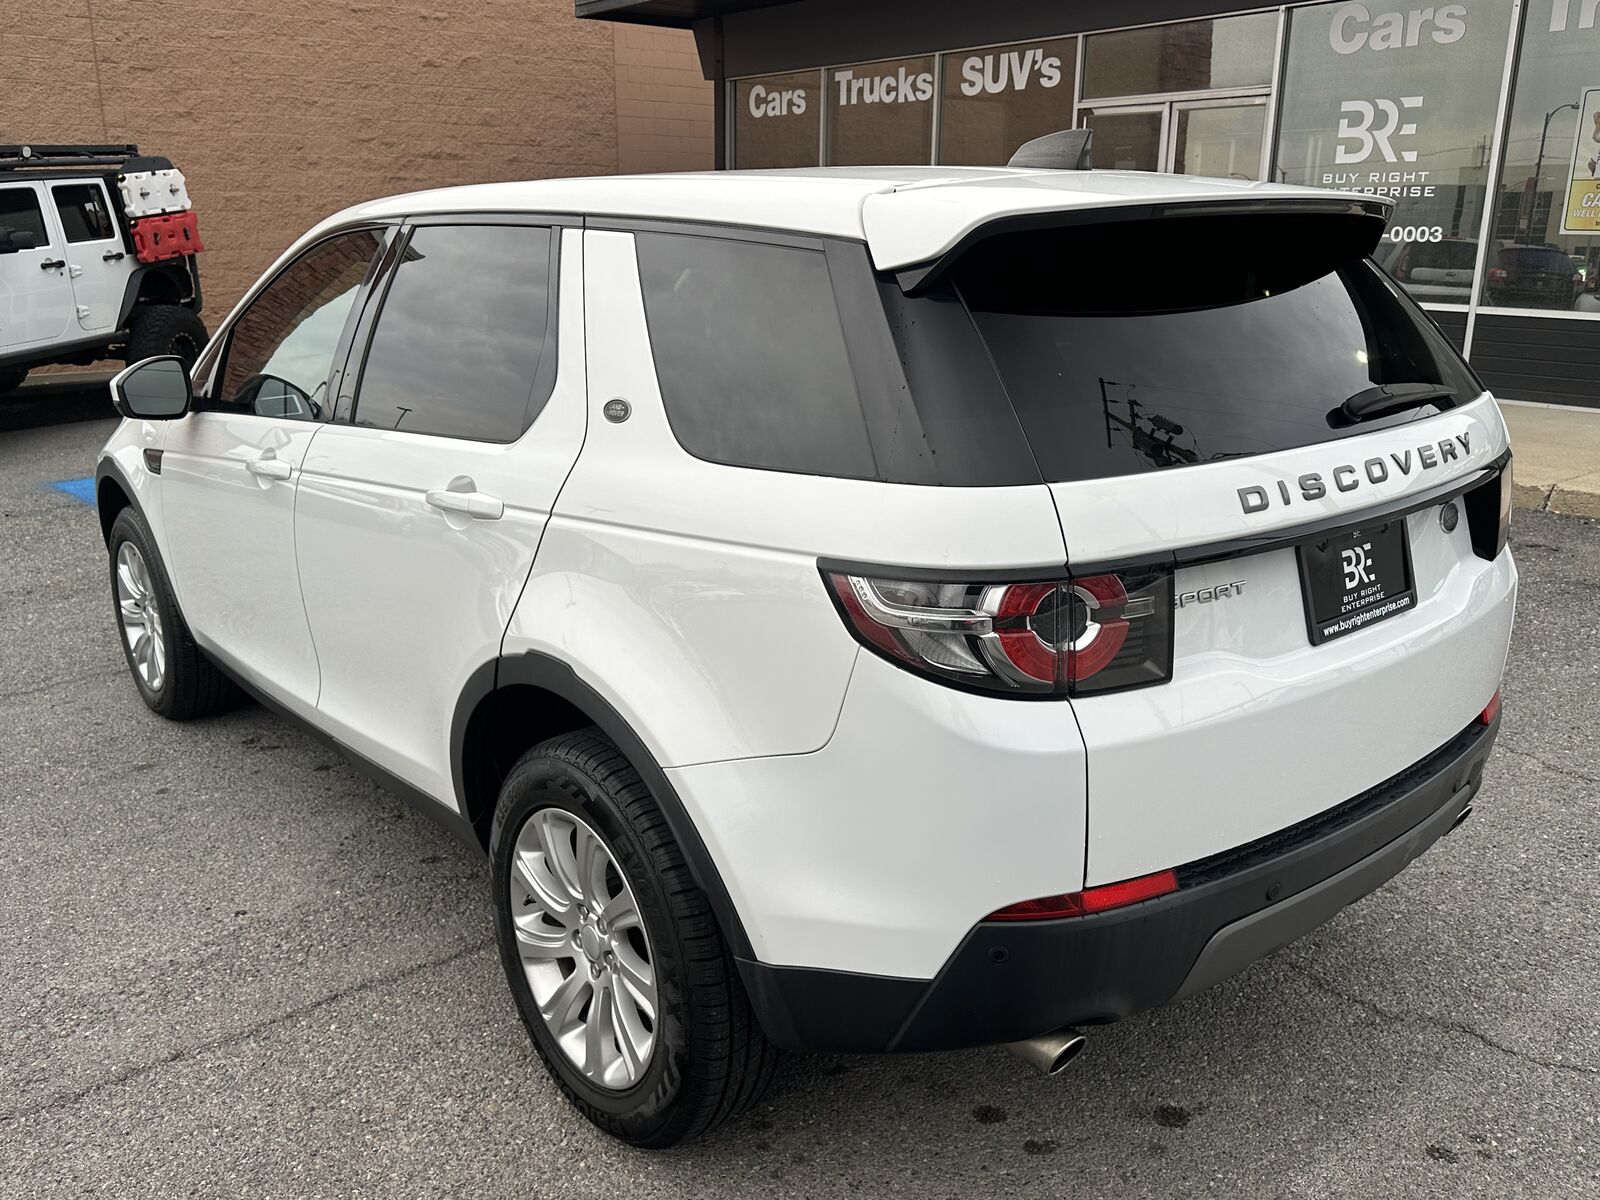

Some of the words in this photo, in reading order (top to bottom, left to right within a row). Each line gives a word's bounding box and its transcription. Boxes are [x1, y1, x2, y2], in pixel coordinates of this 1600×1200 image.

[1329, 3, 1467, 54] Cars
[834, 66, 934, 106] Trucks
[960, 48, 1061, 97] SUV's
[749, 84, 806, 119] Cars
[1334, 96, 1424, 165] BRE
[1322, 173, 1359, 184] BUY
[1368, 171, 1430, 183] RIGHT
[1237, 432, 1472, 514] DISCOVERY
[1341, 542, 1376, 590] BRE
[1341, 591, 1385, 613] ENTERPRISE
[1343, 592, 1358, 603] BUY
[1360, 583, 1381, 597] RIGHT
[1323, 597, 1410, 636] www.buyrightenterprise.com
